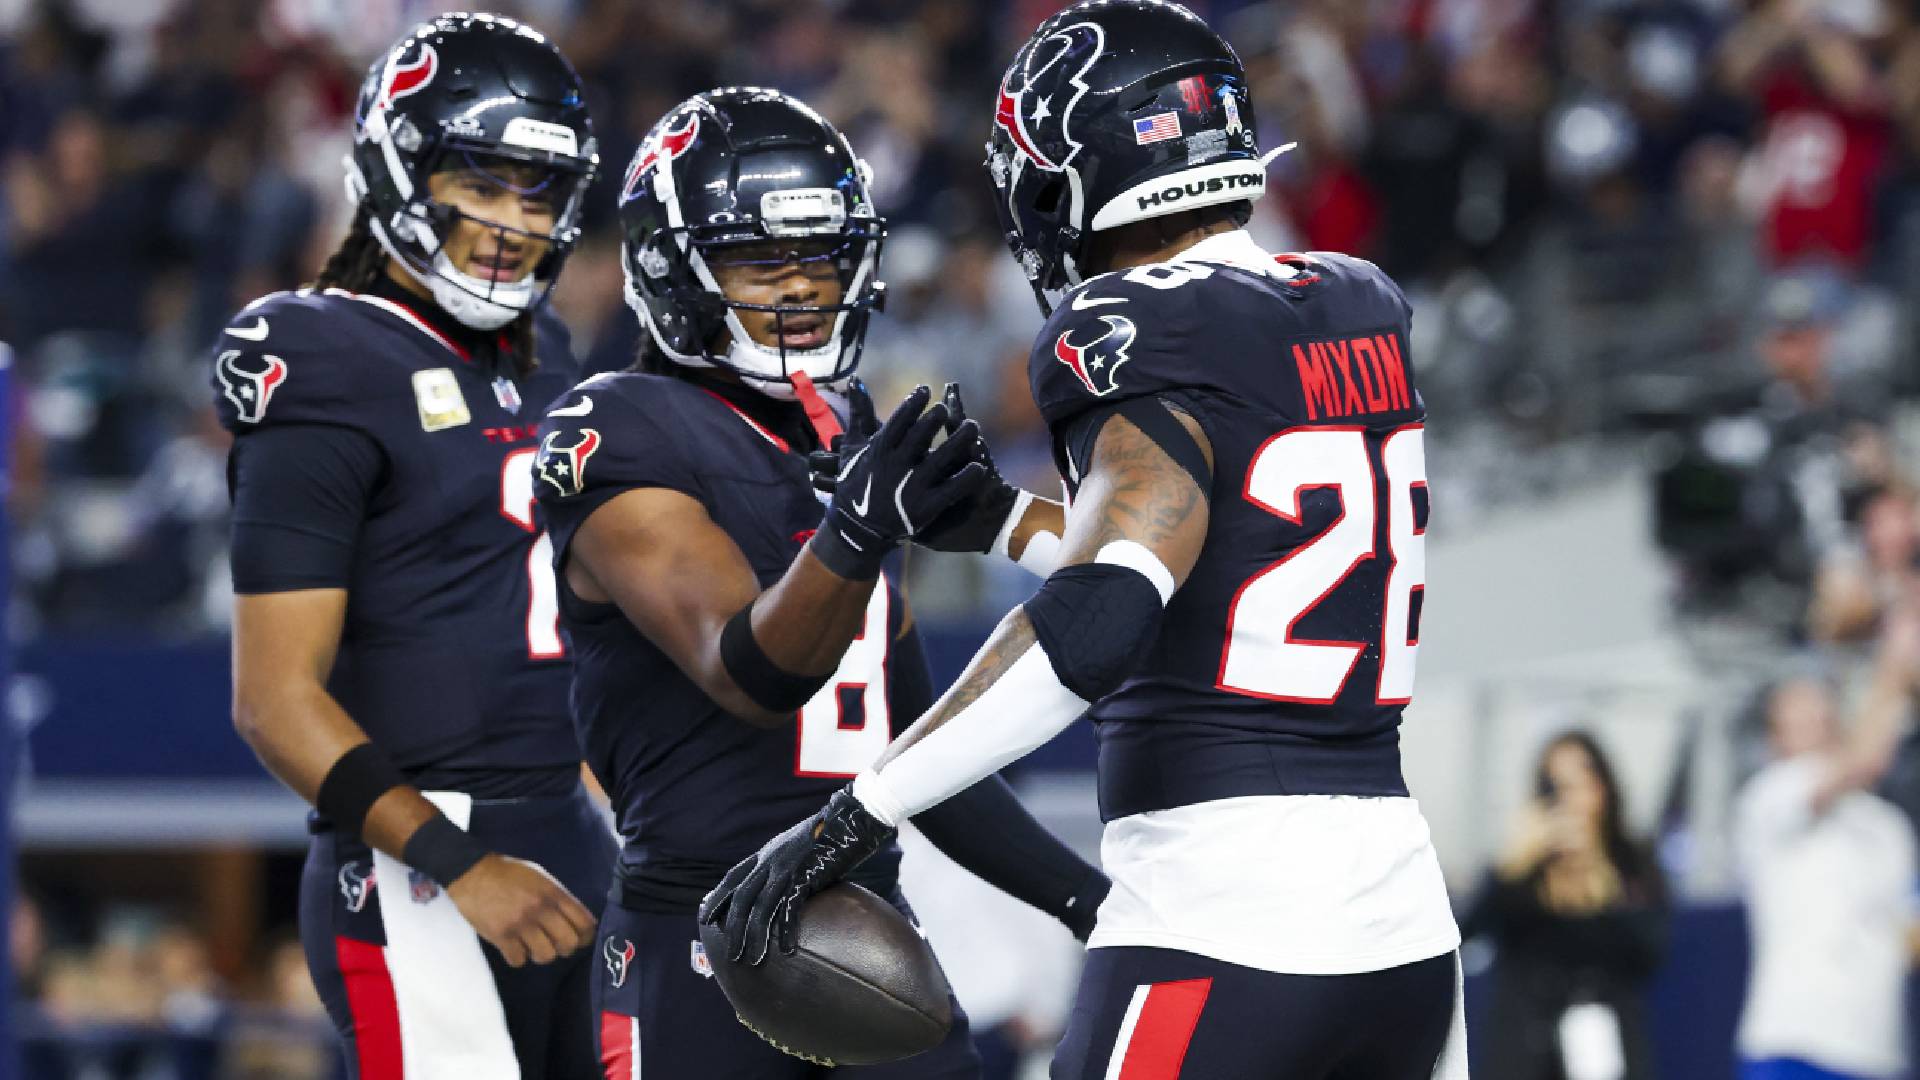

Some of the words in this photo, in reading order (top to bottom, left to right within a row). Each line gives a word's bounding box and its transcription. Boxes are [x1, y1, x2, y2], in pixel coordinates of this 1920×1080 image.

[1137, 173, 1264, 211] HOUSTON
[1291, 333, 1410, 421] MIXON
[1215, 423, 1427, 705] 28
[794, 568, 891, 780] 8
